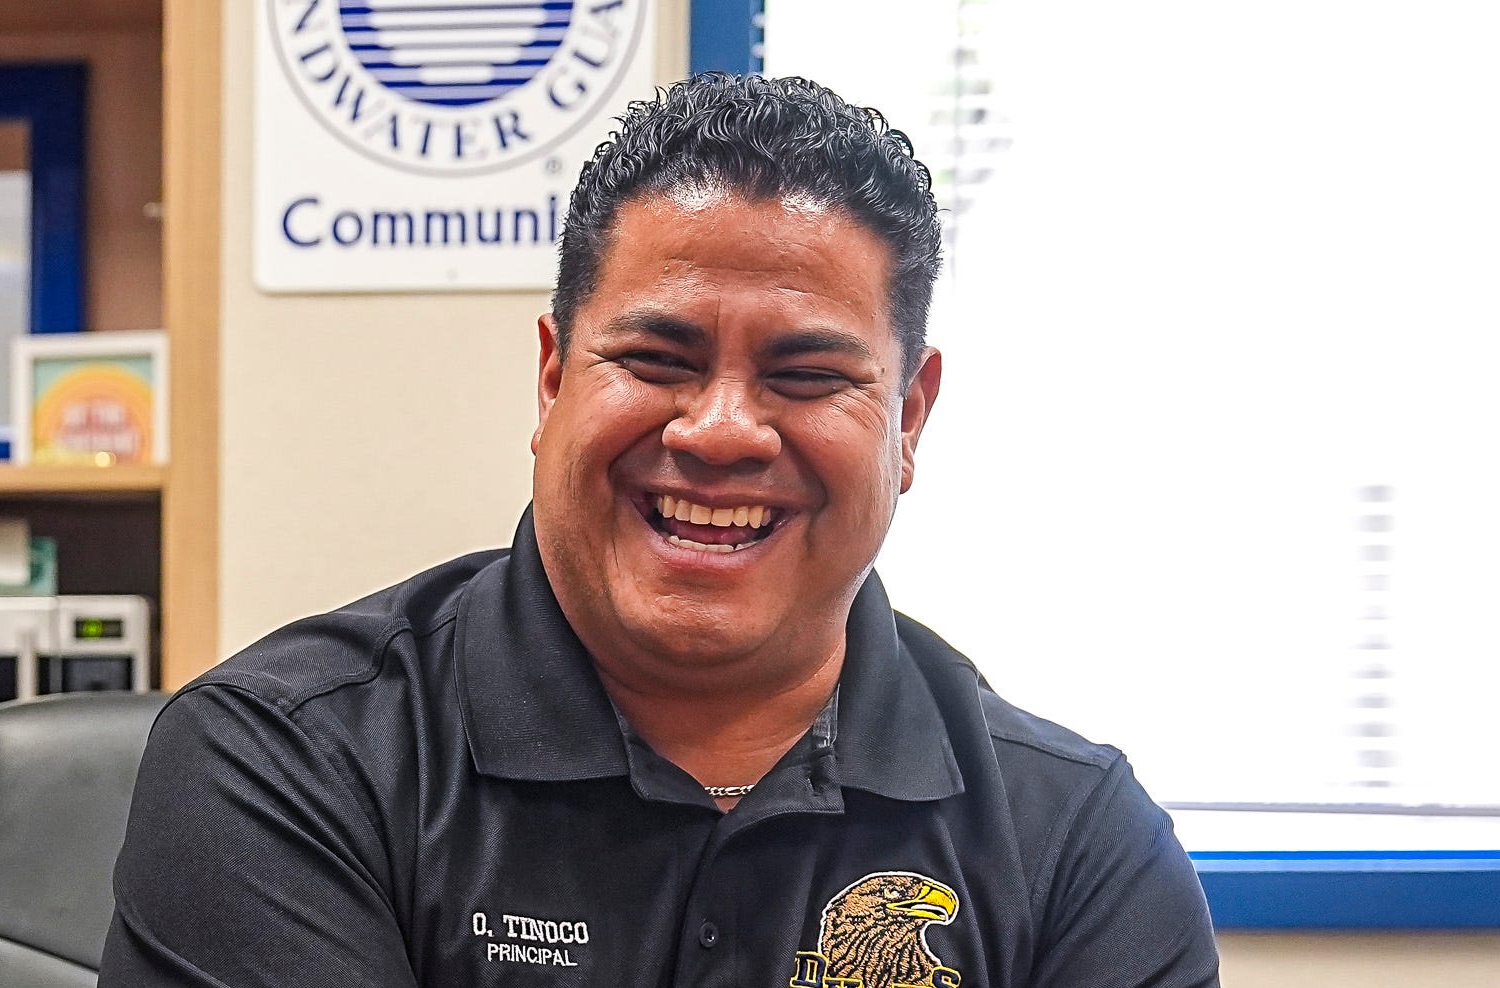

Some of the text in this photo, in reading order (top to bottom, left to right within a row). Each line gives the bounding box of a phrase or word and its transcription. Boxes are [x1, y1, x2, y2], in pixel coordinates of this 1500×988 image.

[282, 195, 557, 248] Communi
[502, 914, 589, 944] TINOCO
[487, 942, 577, 967] PRINCIPAL
